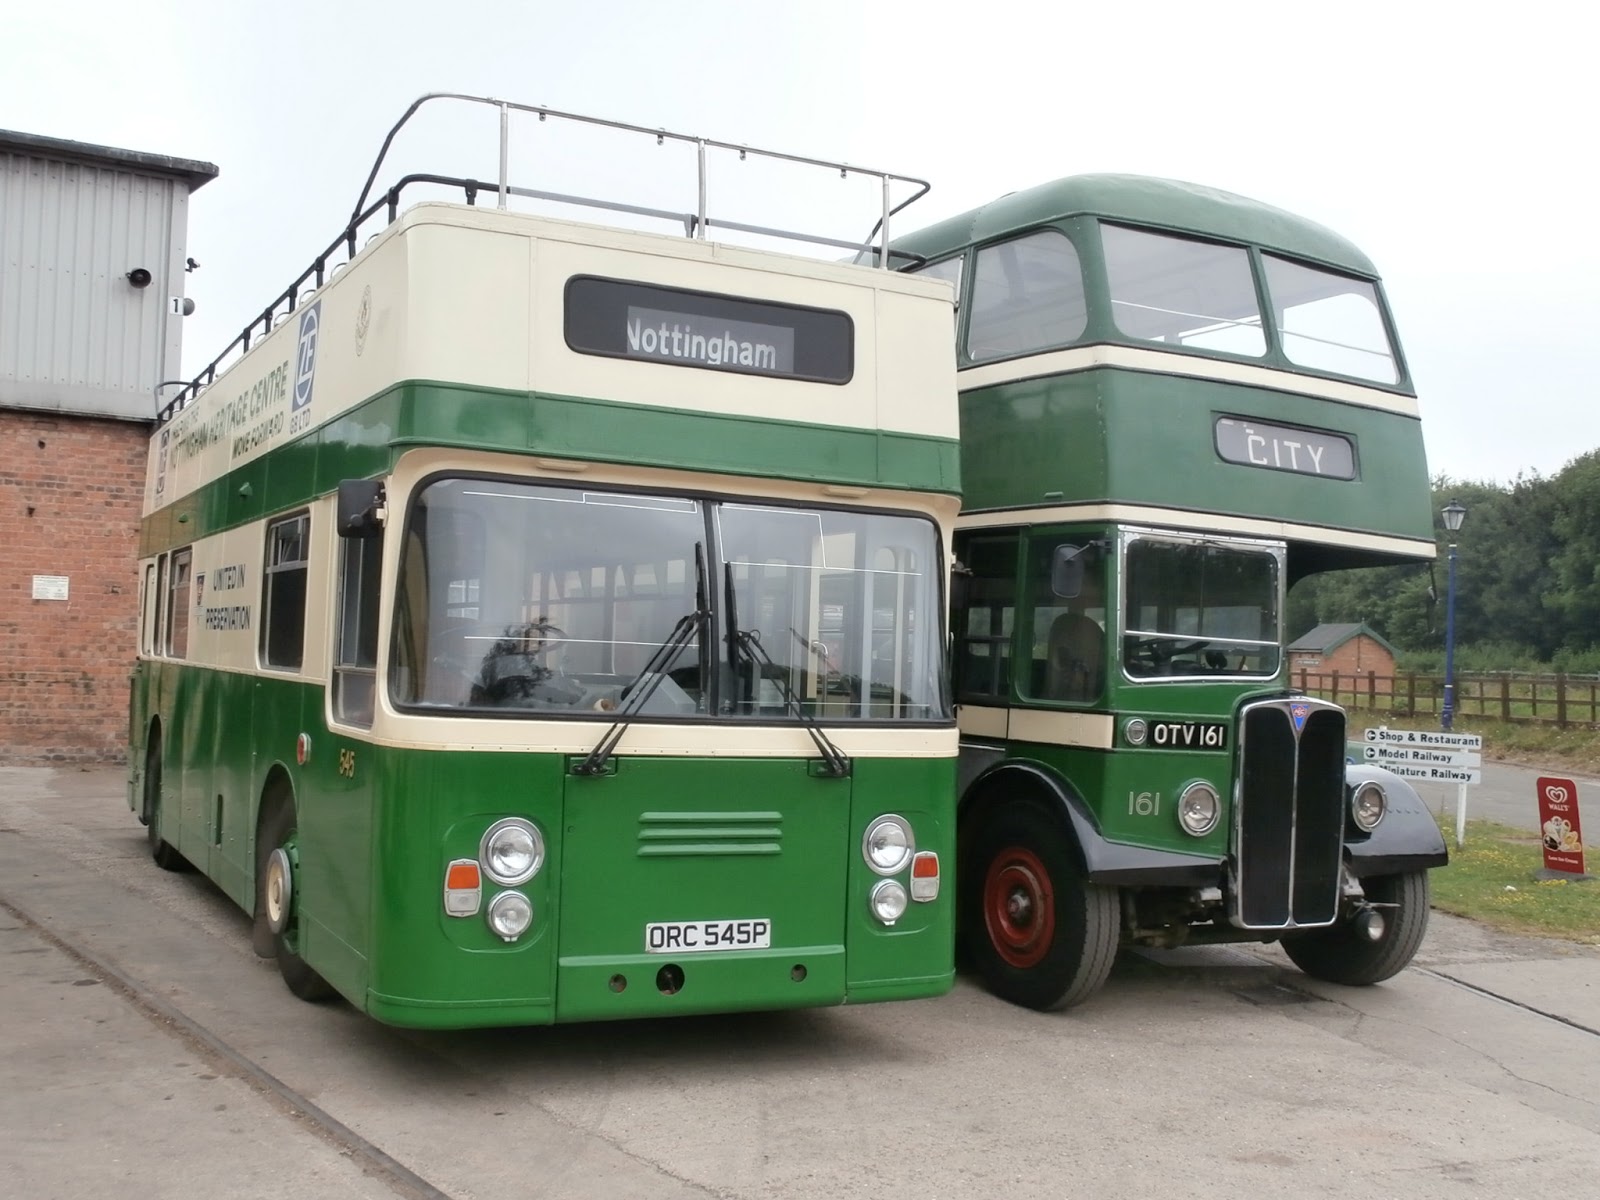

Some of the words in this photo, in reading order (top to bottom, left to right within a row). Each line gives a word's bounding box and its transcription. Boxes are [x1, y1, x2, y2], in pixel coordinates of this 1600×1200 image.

[173, 298, 178, 313] 1
[627, 318, 776, 370] Nottingham
[208, 390, 249, 446] HERITAGE
[249, 360, 289, 418] CENTRE
[299, 408, 310, 431] LTD
[232, 431, 251, 460] MOVE
[250, 410, 284, 450] FORWARD
[1248, 435, 1324, 474] CITY
[213, 566, 237, 591] UNITED
[237, 563, 246, 589] IN
[206, 605, 251, 631] PRESERVATION
[1154, 724, 1195, 744] OTV
[1199, 725, 1224, 747] 161
[1379, 731, 1403, 742] Shop
[1408, 732, 1416, 742] &
[1420, 734, 1480, 746] Restaurant
[340, 748, 355, 778] 545
[1379, 748, 1408, 759] Model
[1412, 751, 1452, 763] Railway
[1431, 768, 1472, 781] Railway
[1128, 791, 1160, 815] 161
[649, 924, 698, 948] ORC
[704, 921, 767, 946] 545P
